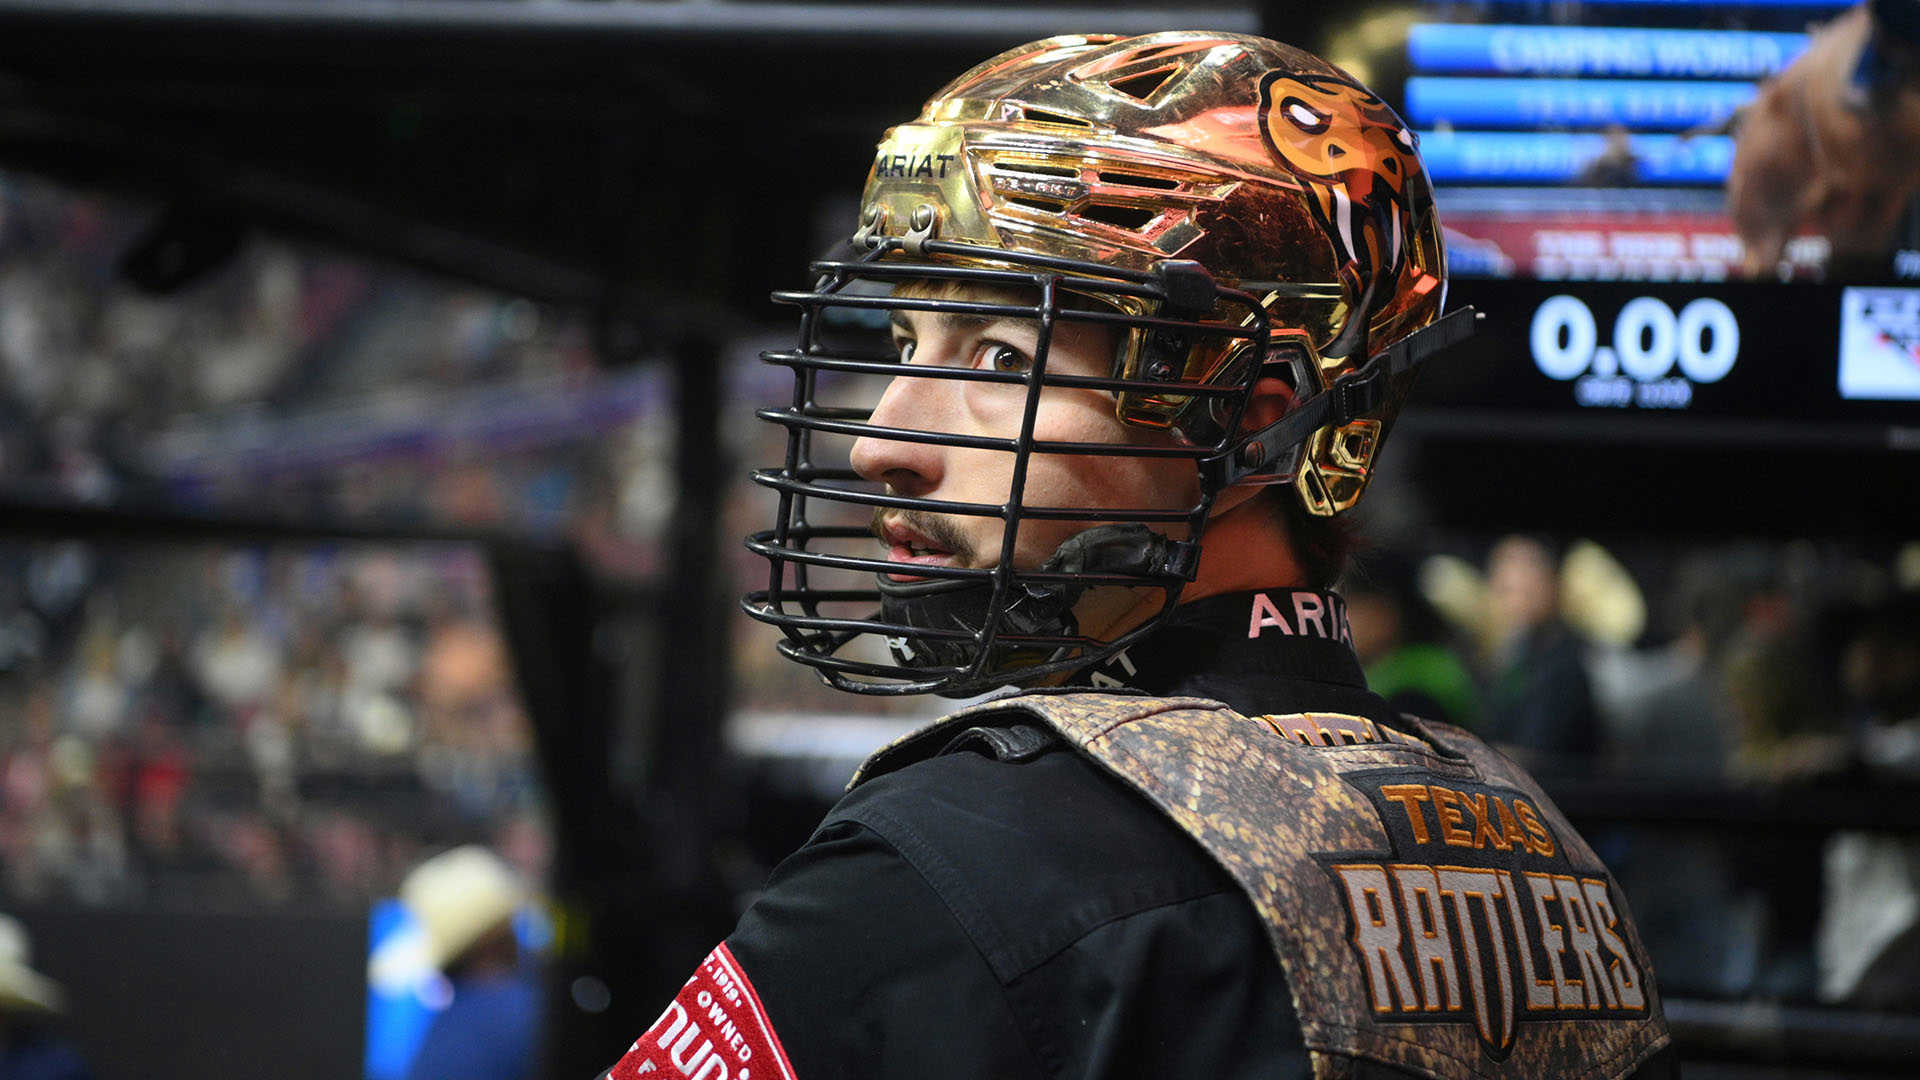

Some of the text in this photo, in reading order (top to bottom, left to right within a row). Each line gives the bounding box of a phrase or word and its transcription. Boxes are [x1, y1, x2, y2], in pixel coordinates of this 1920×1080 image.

[876, 154, 954, 178] ARIAT
[1530, 294, 1740, 384] 0.00
[1380, 784, 1556, 858] TEXAS
[1332, 863, 1645, 1049] RATTLERS
[697, 990, 752, 1062] OWNED
